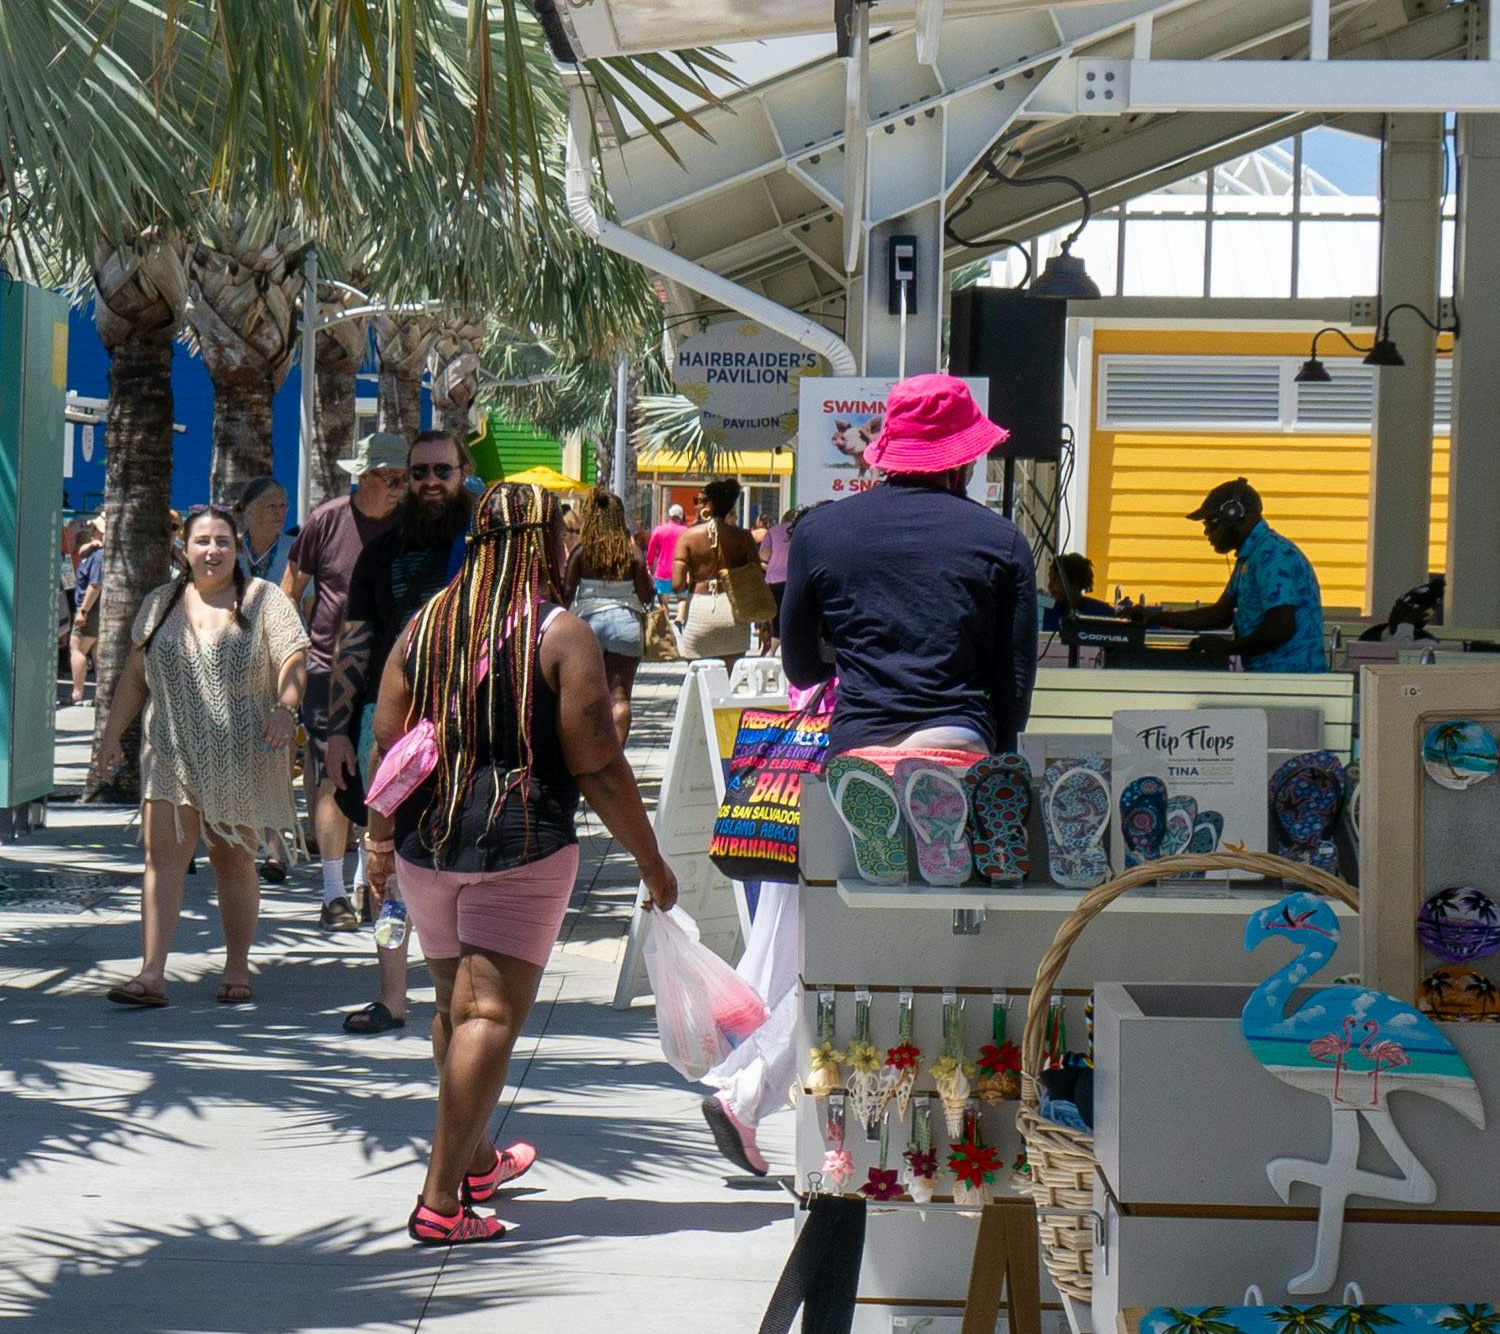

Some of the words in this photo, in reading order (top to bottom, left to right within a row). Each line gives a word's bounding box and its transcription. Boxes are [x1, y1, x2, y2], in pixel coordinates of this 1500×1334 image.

[679, 351, 817, 369] HAIRBRAIDER'S
[707, 368, 789, 384] PAVILION
[723, 417, 781, 429] PAVILION
[832, 478, 844, 492] &
[1136, 725, 1180, 756] Flip
[1179, 725, 1235, 756] Flops
[769, 758, 822, 775] ELEUTHERA
[1167, 766, 1199, 776] TINA
[749, 772, 800, 808] BAH
[731, 805, 753, 820] SAN
[751, 806, 800, 825] SALVADOR
[759, 822, 797, 843] ABACO
[728, 837, 797, 864] BAHAMAS
